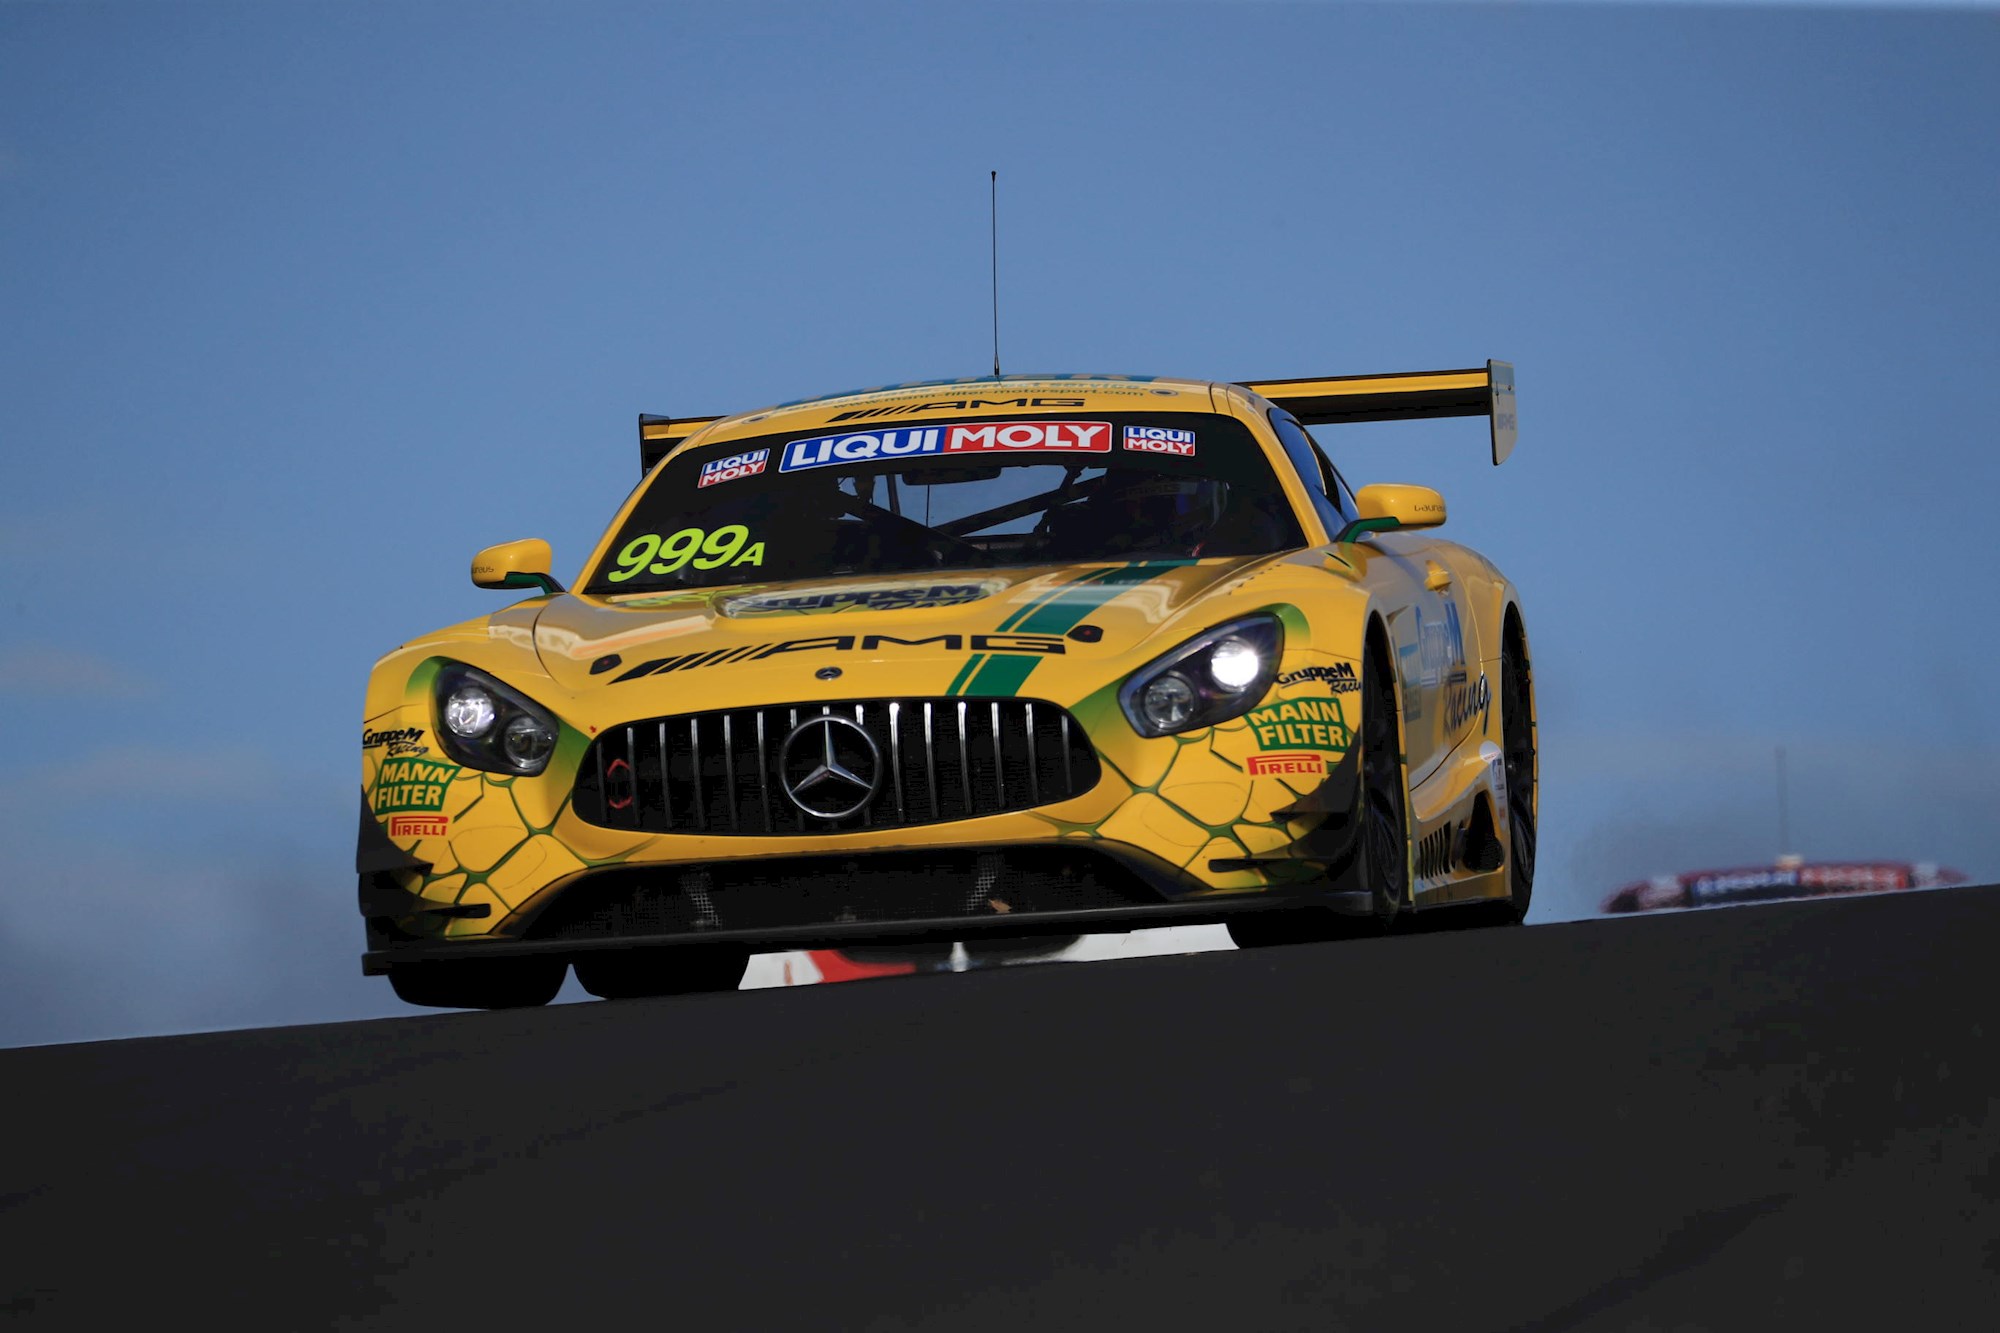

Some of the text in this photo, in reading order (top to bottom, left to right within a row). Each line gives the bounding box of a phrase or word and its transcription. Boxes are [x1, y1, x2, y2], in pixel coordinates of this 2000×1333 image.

[908, 398, 1085, 413] AMG
[789, 425, 1107, 467] LIQUI MOLY
[1128, 427, 1191, 442] LIQUI
[1128, 438, 1192, 454] MOLY
[702, 462, 763, 485] MOLY
[704, 450, 765, 475] LIQUI
[750, 634, 1067, 661] AMG
[1277, 662, 1356, 684] GruppeM
[1247, 701, 1340, 726] MANN
[1257, 723, 1345, 747] FILTER
[380, 762, 455, 785] MANN
[1247, 754, 1322, 775] PIRELLI
[377, 784, 442, 809] FILTER
[391, 815, 449, 837] PIRELLI
